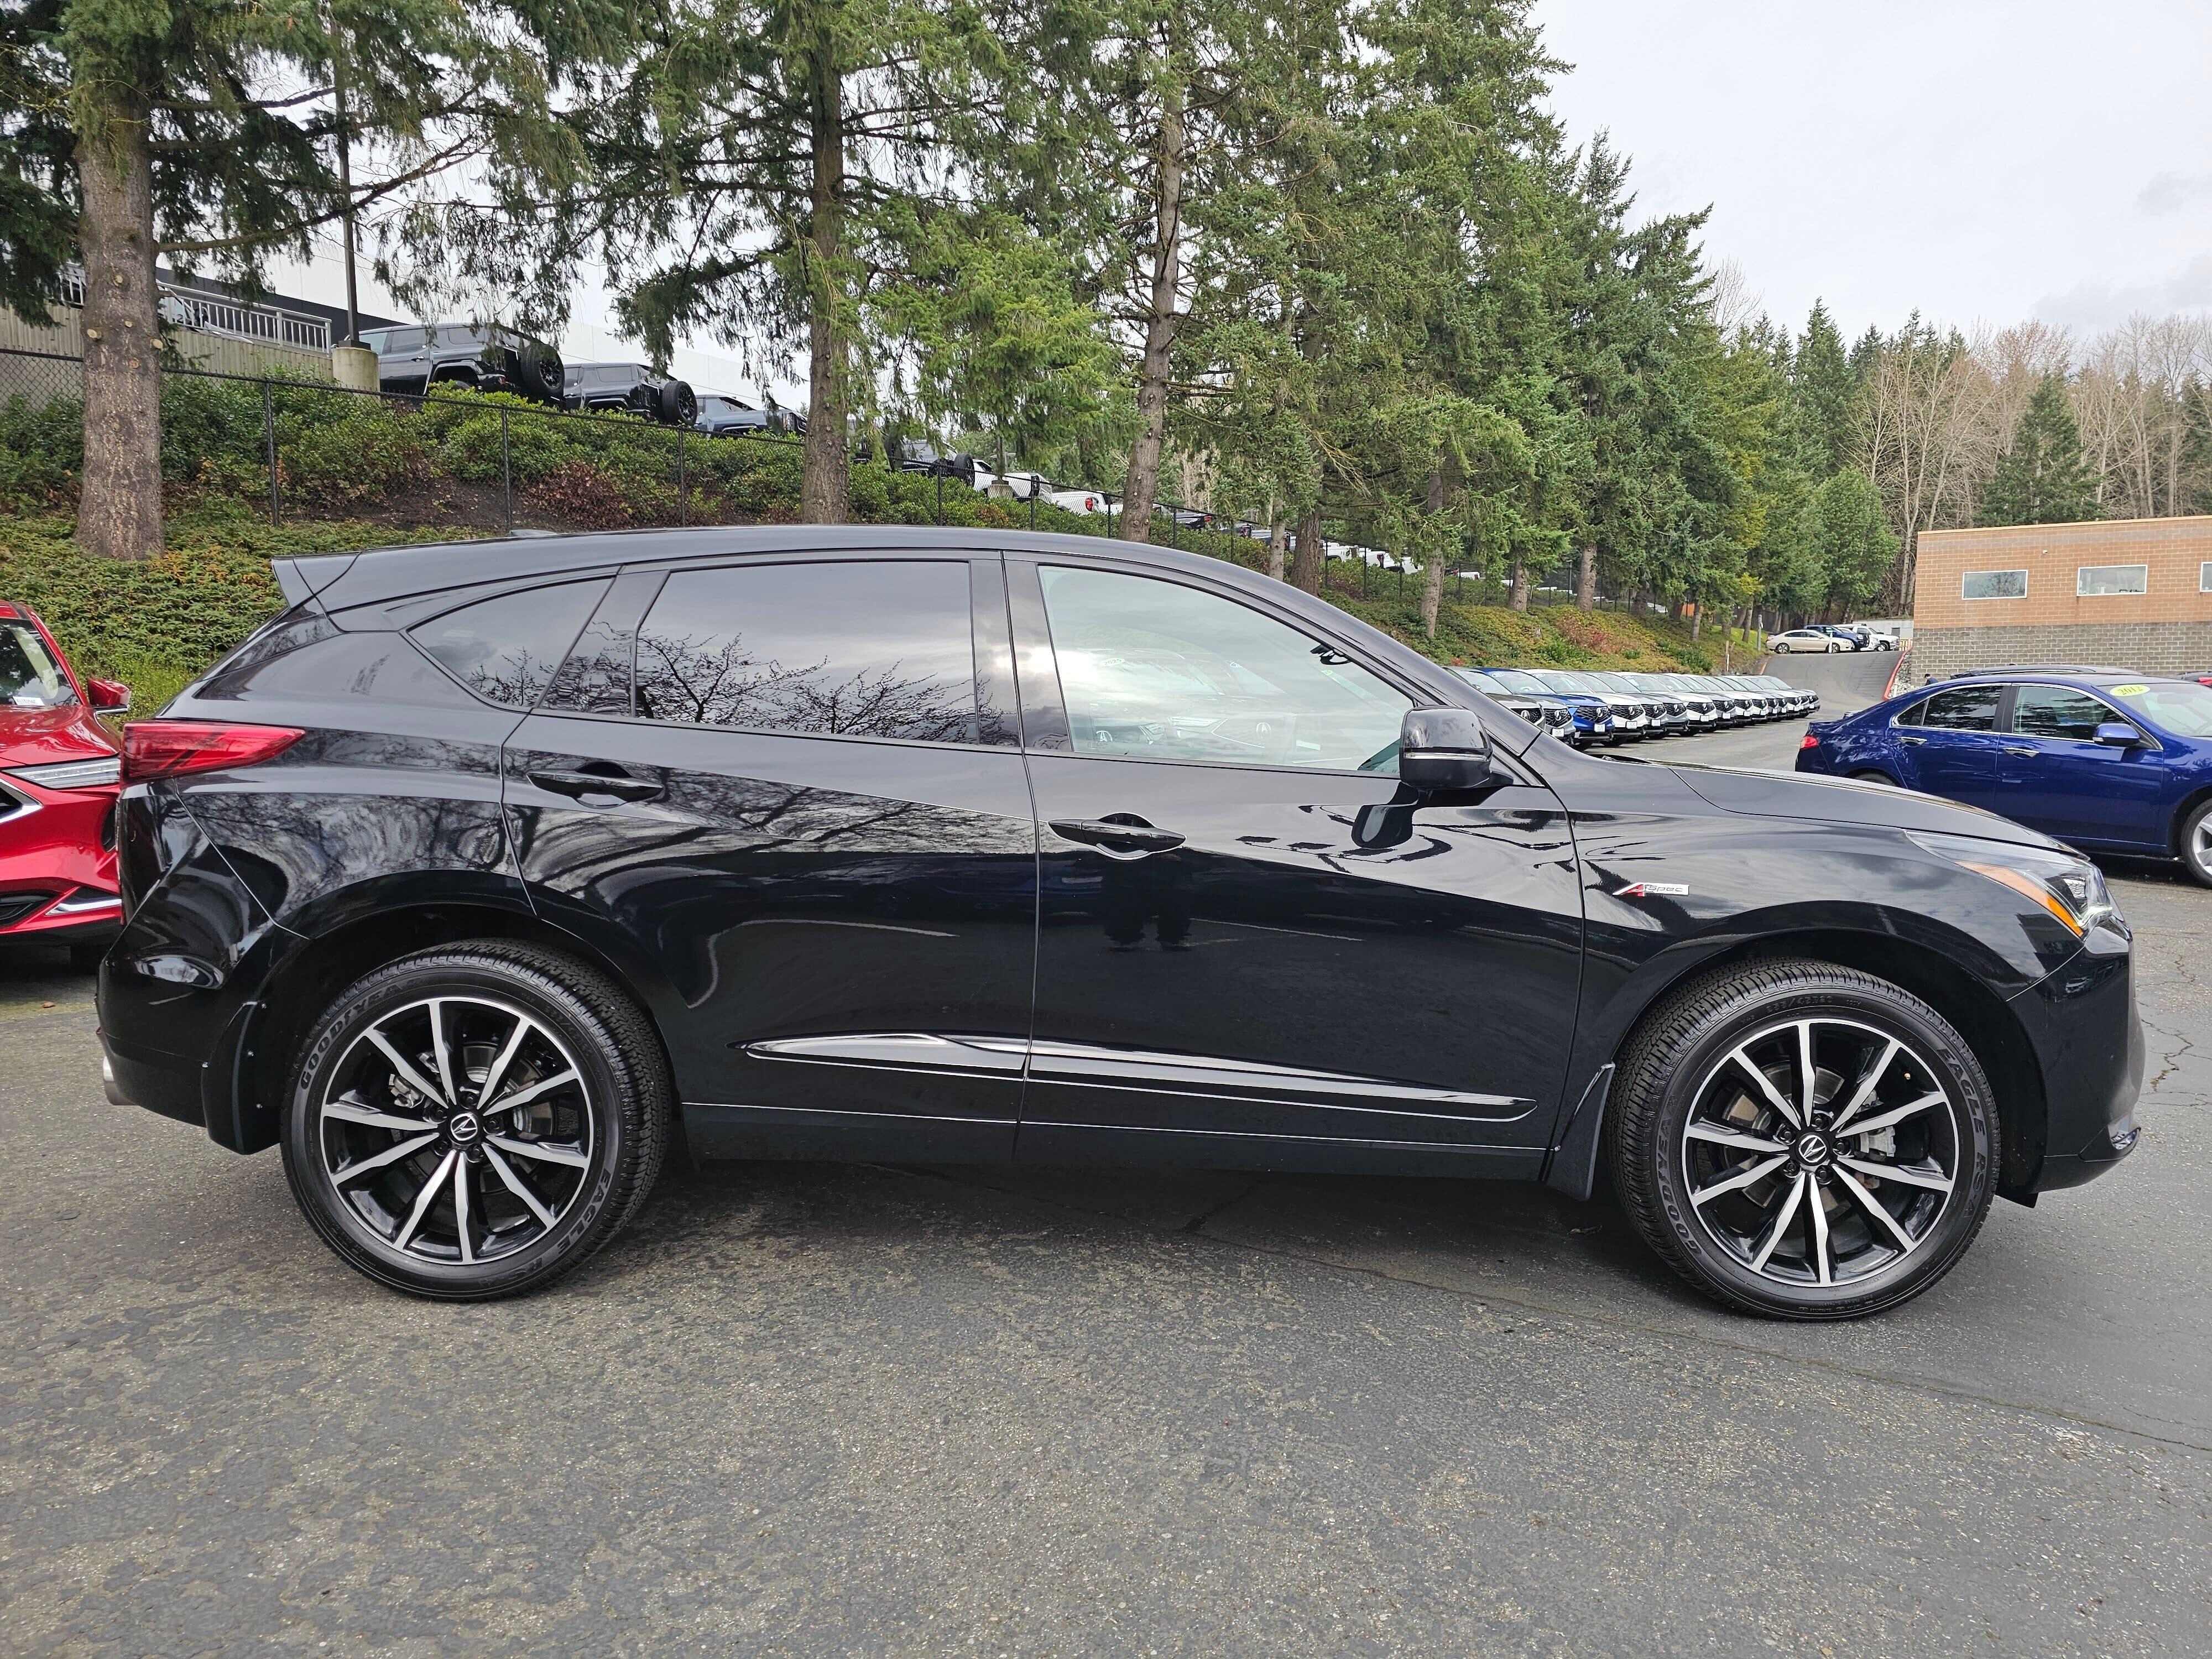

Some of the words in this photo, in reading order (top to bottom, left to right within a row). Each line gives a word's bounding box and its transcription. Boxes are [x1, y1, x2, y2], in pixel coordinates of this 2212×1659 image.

[2117, 686, 2143, 695] 2012
[300, 977, 424, 1090] GOODYEAR
[1937, 1048, 1986, 1136] EAGLE
[557, 1168, 611, 1254] EAGLE
[1657, 1094, 1702, 1255] GOODYEAR
